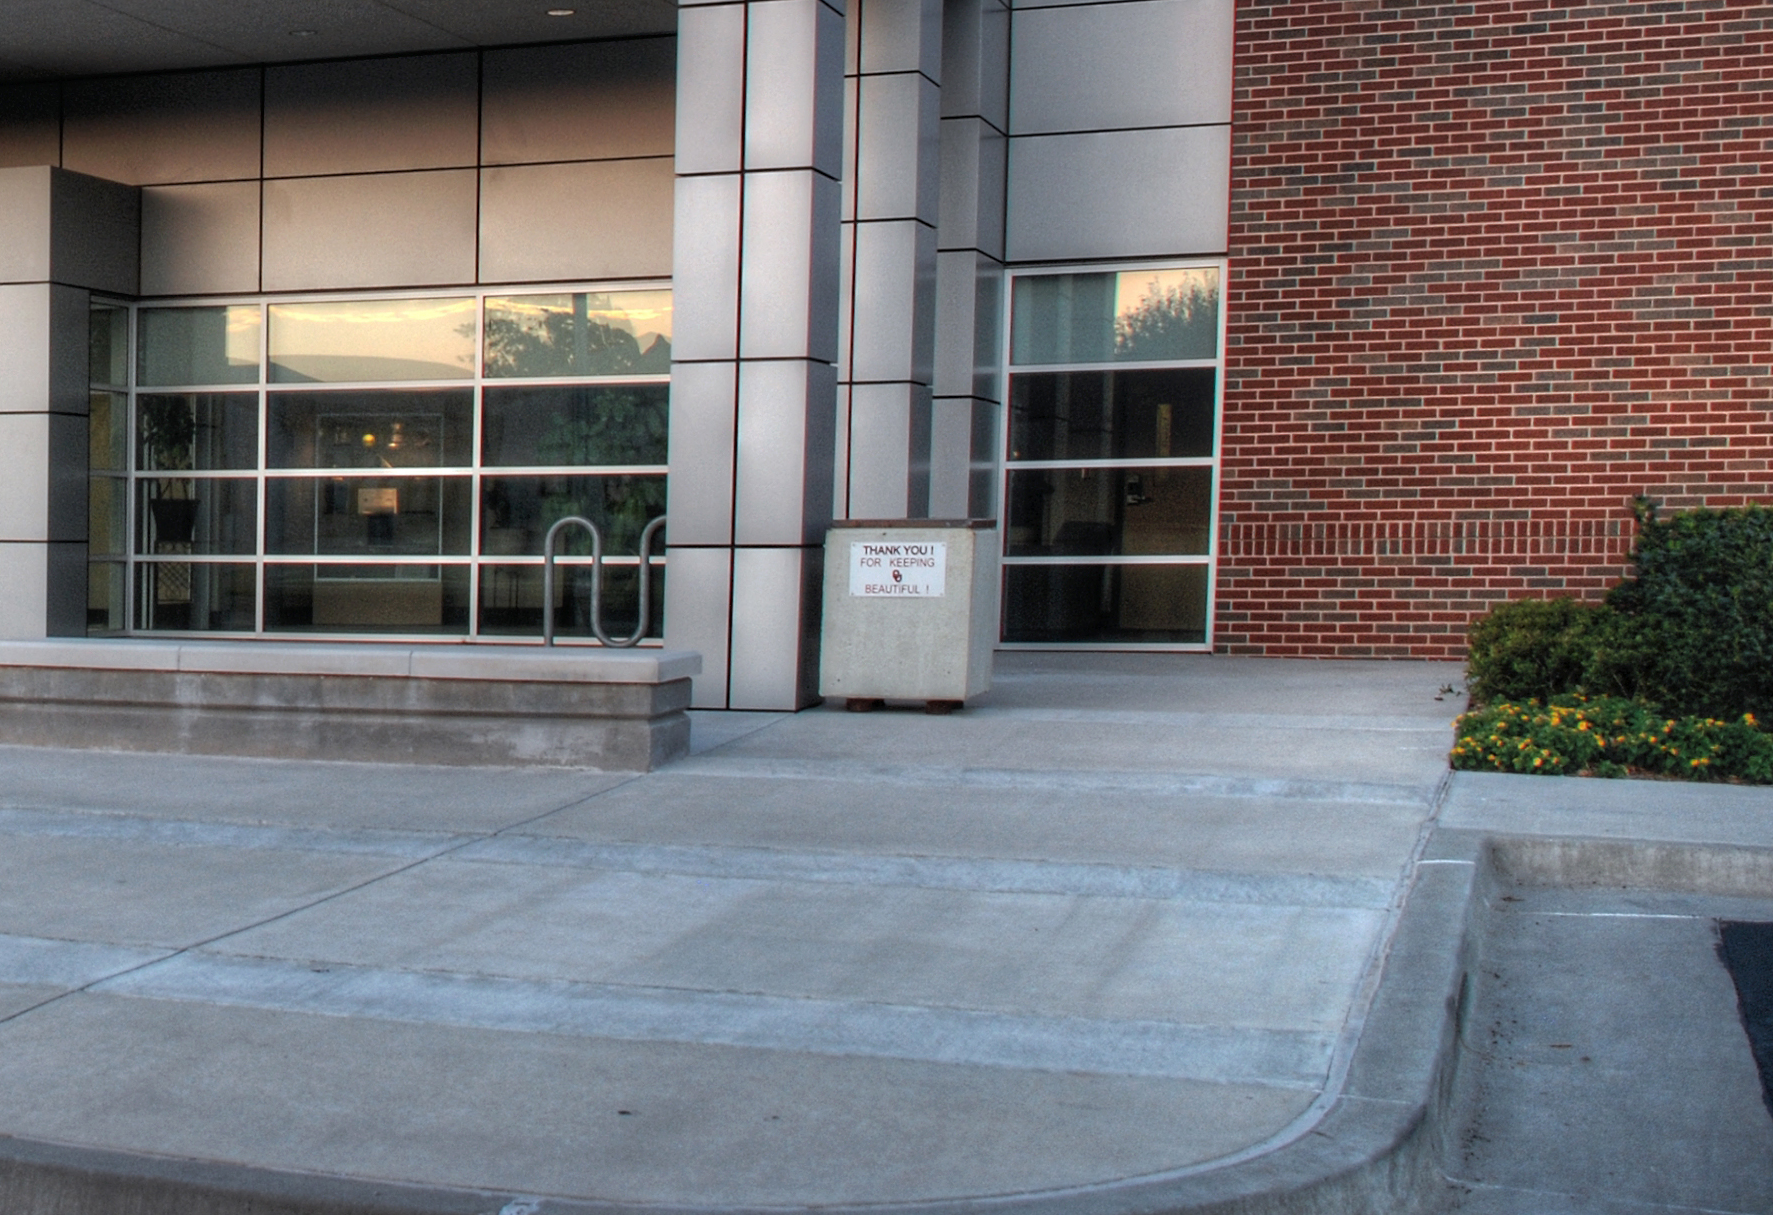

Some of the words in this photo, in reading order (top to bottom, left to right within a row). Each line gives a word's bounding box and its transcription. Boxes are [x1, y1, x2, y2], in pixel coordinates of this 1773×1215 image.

[863, 545, 901, 556] THANK
[860, 558, 882, 568] FOR
[889, 557, 935, 568] KEEPING
[864, 584, 920, 595] BEAUTIFUL
